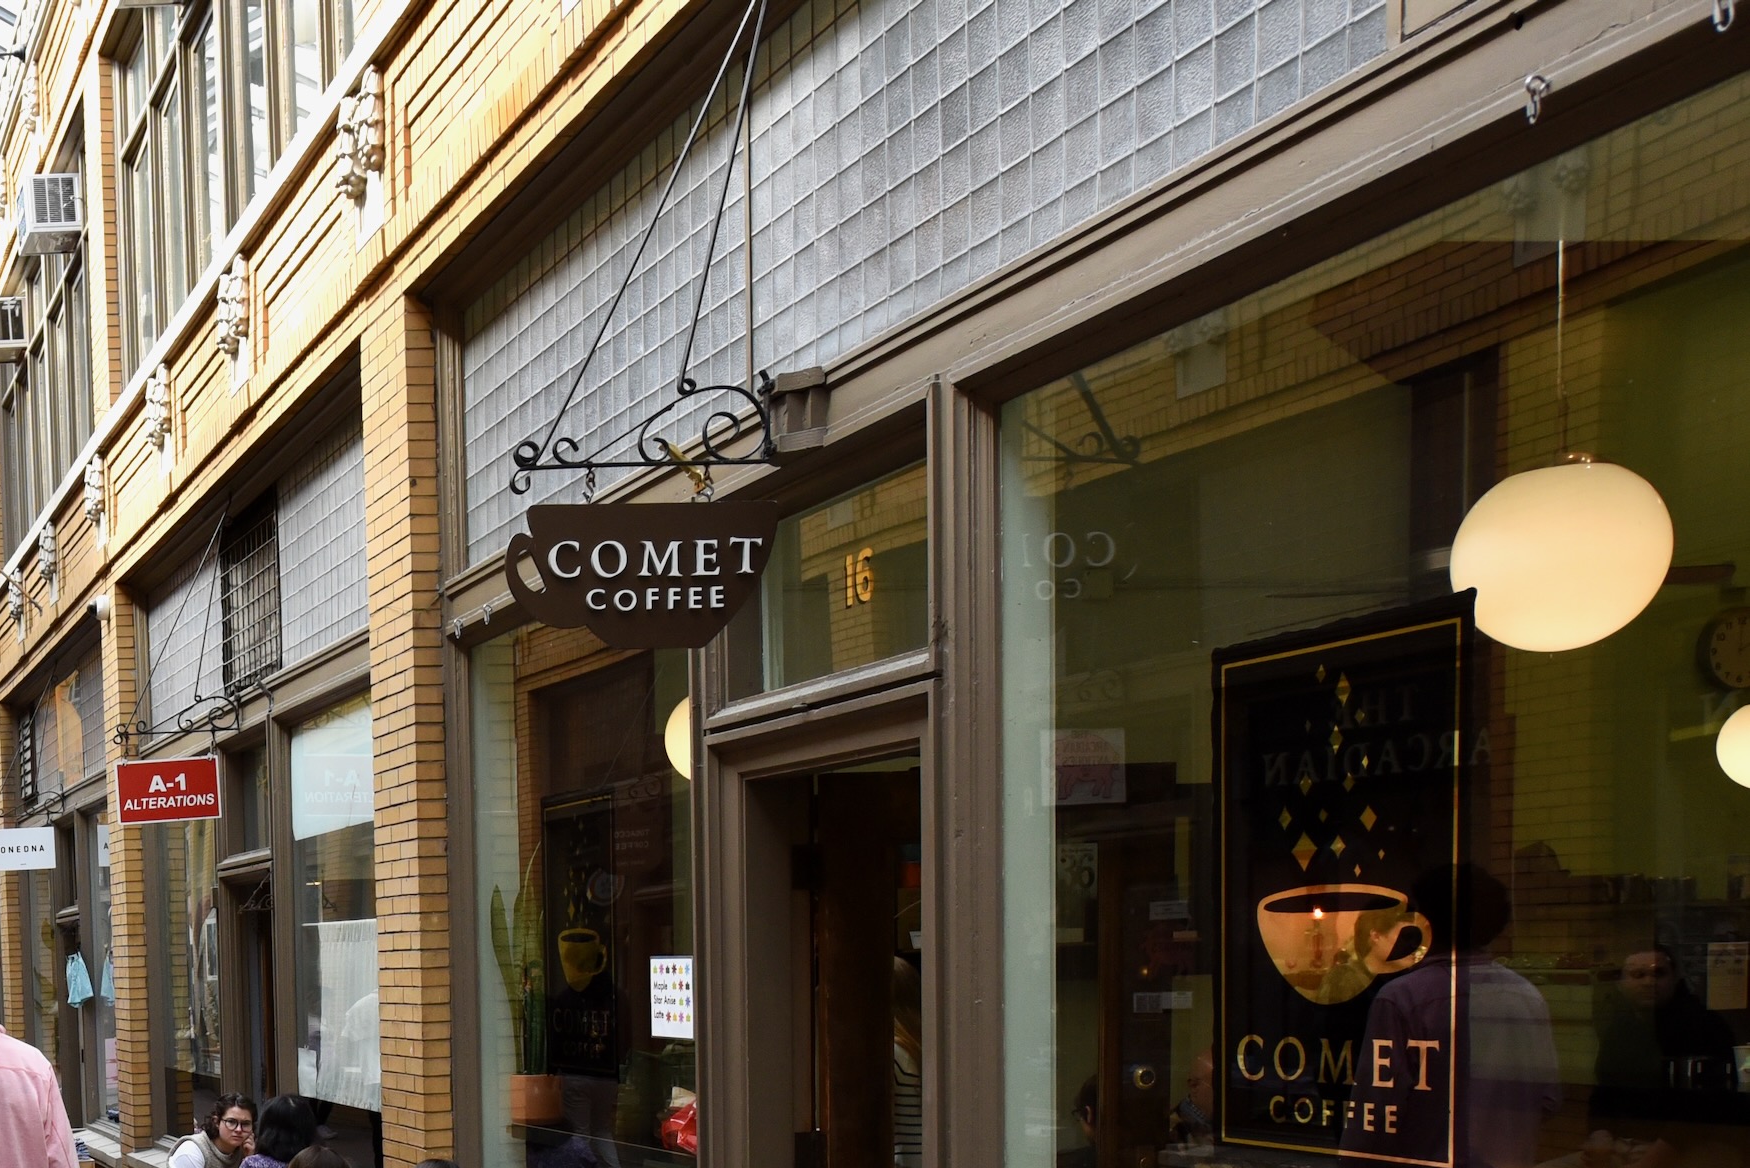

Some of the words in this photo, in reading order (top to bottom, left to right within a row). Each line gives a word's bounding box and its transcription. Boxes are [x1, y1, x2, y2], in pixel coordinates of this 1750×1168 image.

[548, 536, 763, 578] COMET
[844, 547, 874, 609] 16
[586, 585, 725, 611] COFFEE
[149, 773, 186, 793] A-1
[124, 793, 215, 811] ALTERATIONS
[0, 845, 45, 854] ONEDNA
[653, 979, 668, 993] Maple
[653, 995, 663, 1005] Star
[664, 995, 676, 1005] Anise
[654, 1009, 665, 1019] Latte
[1237, 1034, 1440, 1091] COMET
[1269, 1095, 1397, 1133] COFFEE
